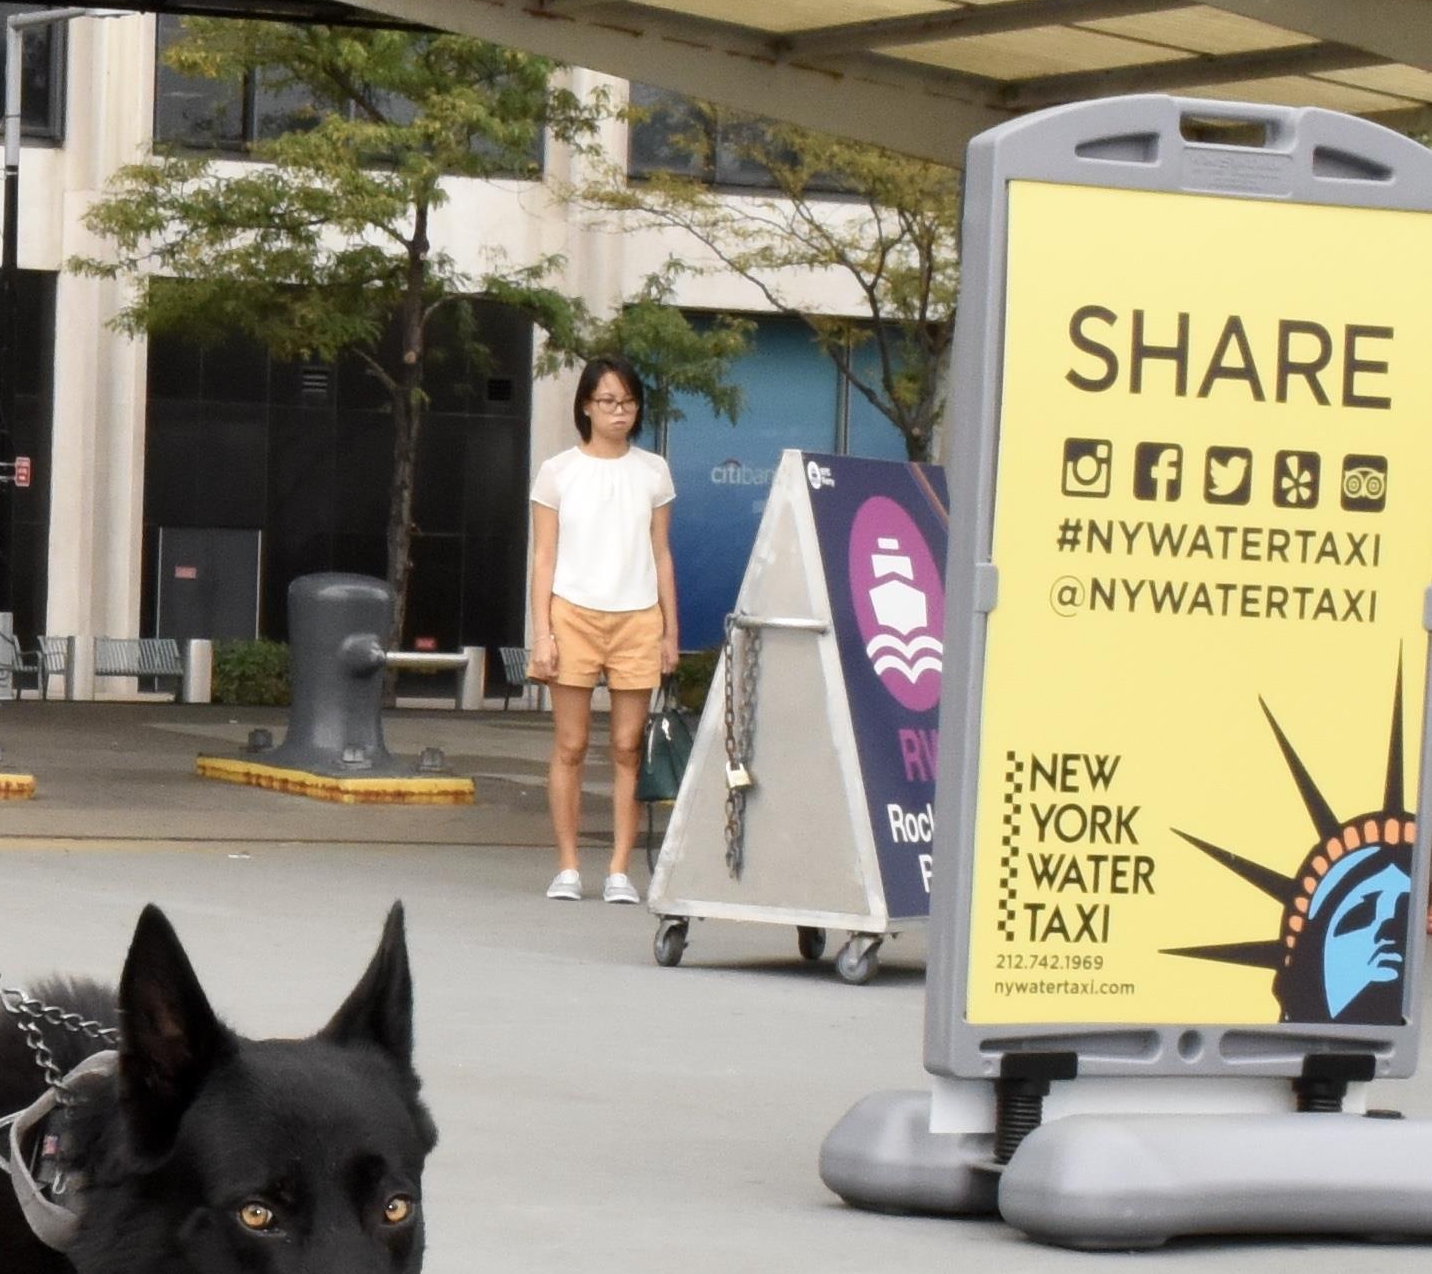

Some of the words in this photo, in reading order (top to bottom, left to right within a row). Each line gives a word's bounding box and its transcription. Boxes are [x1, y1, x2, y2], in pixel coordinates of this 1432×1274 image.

[1065, 304, 1394, 410] SHARE
[1057, 518, 1381, 567] #NYWATERTAXI
[1050, 575, 1377, 623] @NYWATERTAXI
[1030, 752, 1121, 793] NEW
[1030, 803, 1141, 845] YORK
[1027, 853, 1155, 894] WATER
[1023, 903, 1110, 943] TAXI
[996, 954, 1104, 970] 212.742.1969
[994, 978, 1135, 997] nywatertaxi.com
